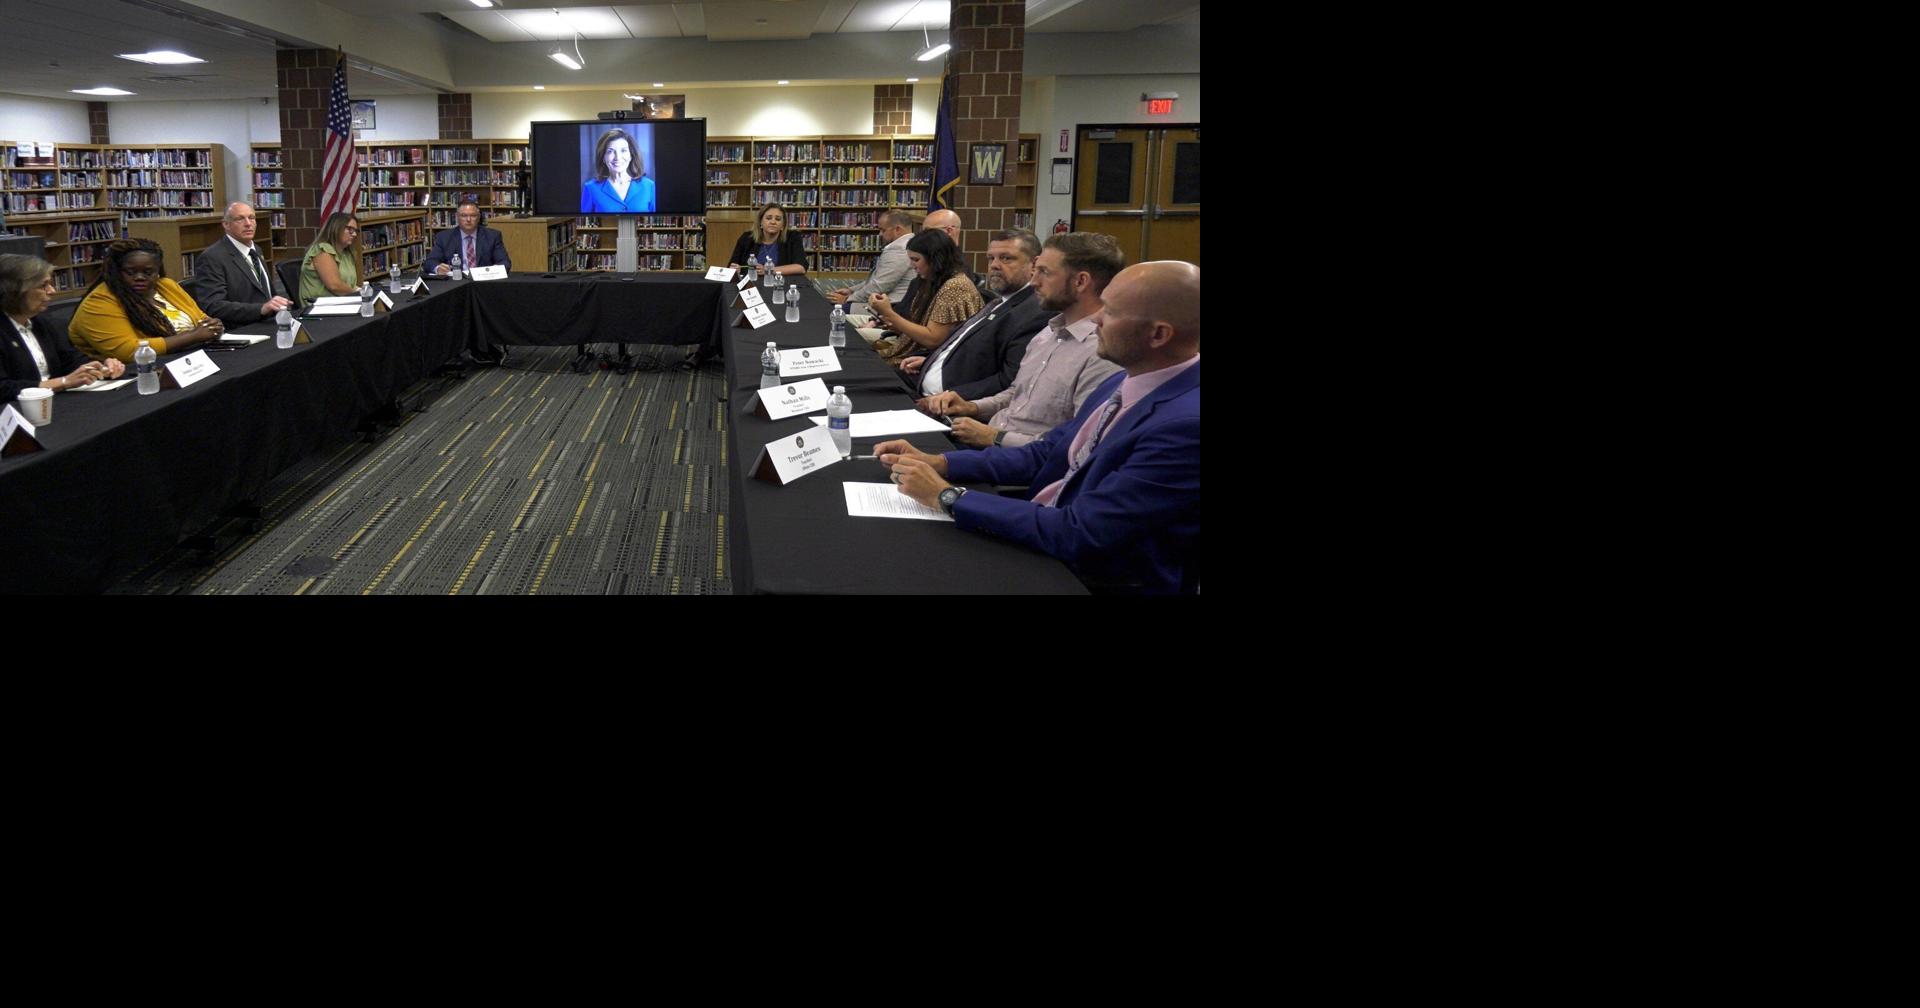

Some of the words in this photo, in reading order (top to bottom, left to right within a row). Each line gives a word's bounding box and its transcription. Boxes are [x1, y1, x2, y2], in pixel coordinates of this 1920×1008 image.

[1151, 99, 1172, 114] EXIT
[974, 151, 1002, 178] W
[788, 453, 803, 464] Trevor
